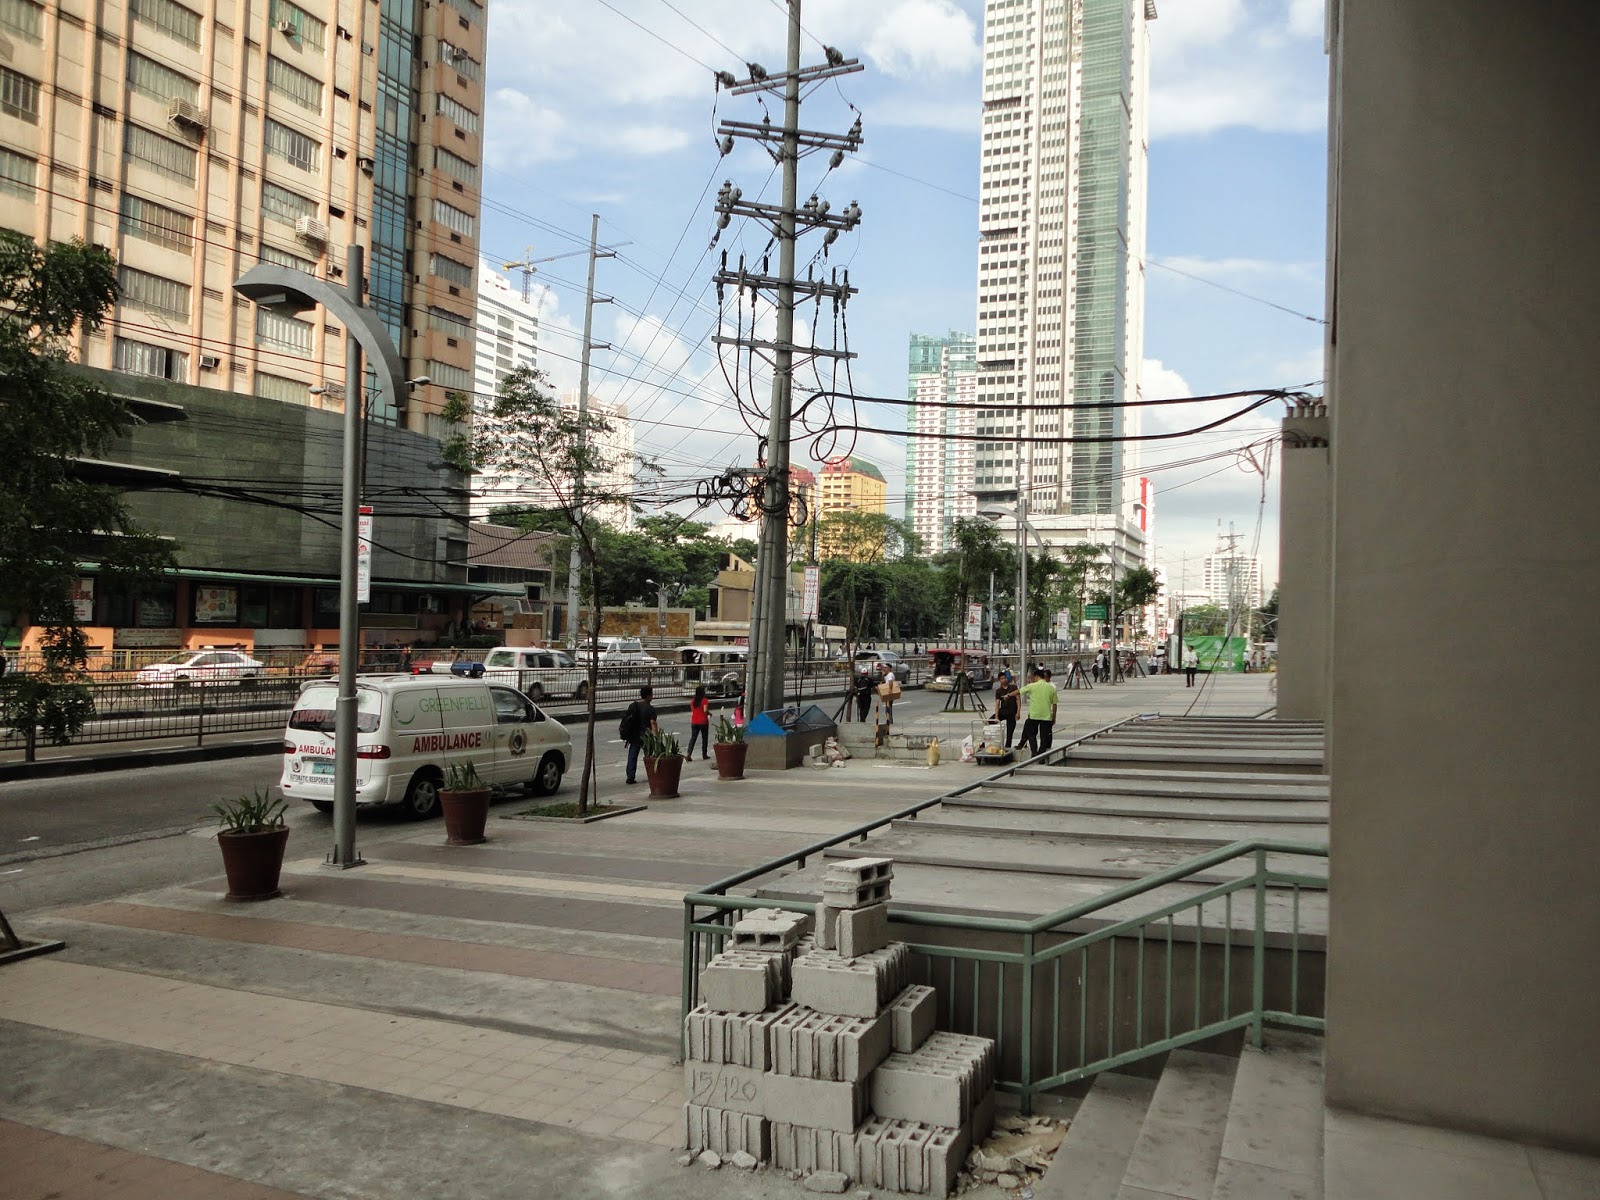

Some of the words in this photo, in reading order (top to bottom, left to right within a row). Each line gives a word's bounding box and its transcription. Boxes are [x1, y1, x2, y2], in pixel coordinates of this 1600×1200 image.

[419, 696, 489, 713] GREENFIELD
[412, 732, 482, 753] AMBULANCE
[309, 775, 329, 784] RESPONSE
